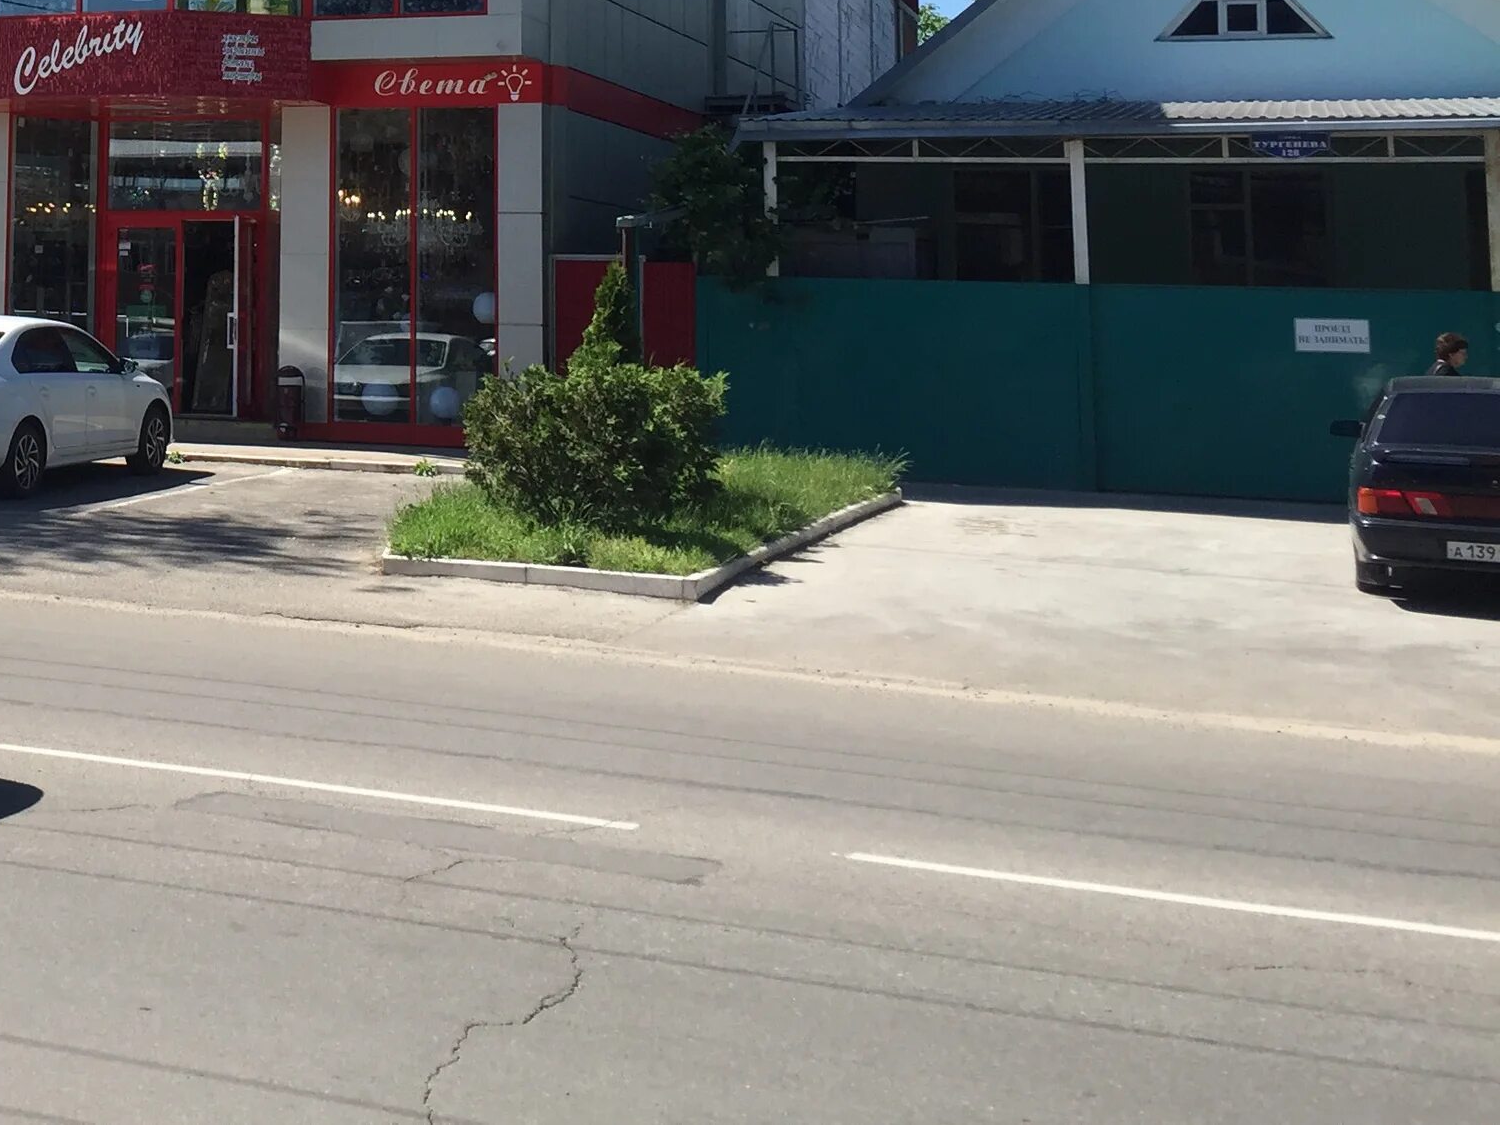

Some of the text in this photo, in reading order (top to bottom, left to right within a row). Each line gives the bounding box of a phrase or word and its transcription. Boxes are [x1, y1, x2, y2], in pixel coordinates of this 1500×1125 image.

[14, 19, 144, 95] Celebrity
[374, 68, 489, 96] Света
[1253, 140, 1328, 148] ТУРГЕНЕВА
